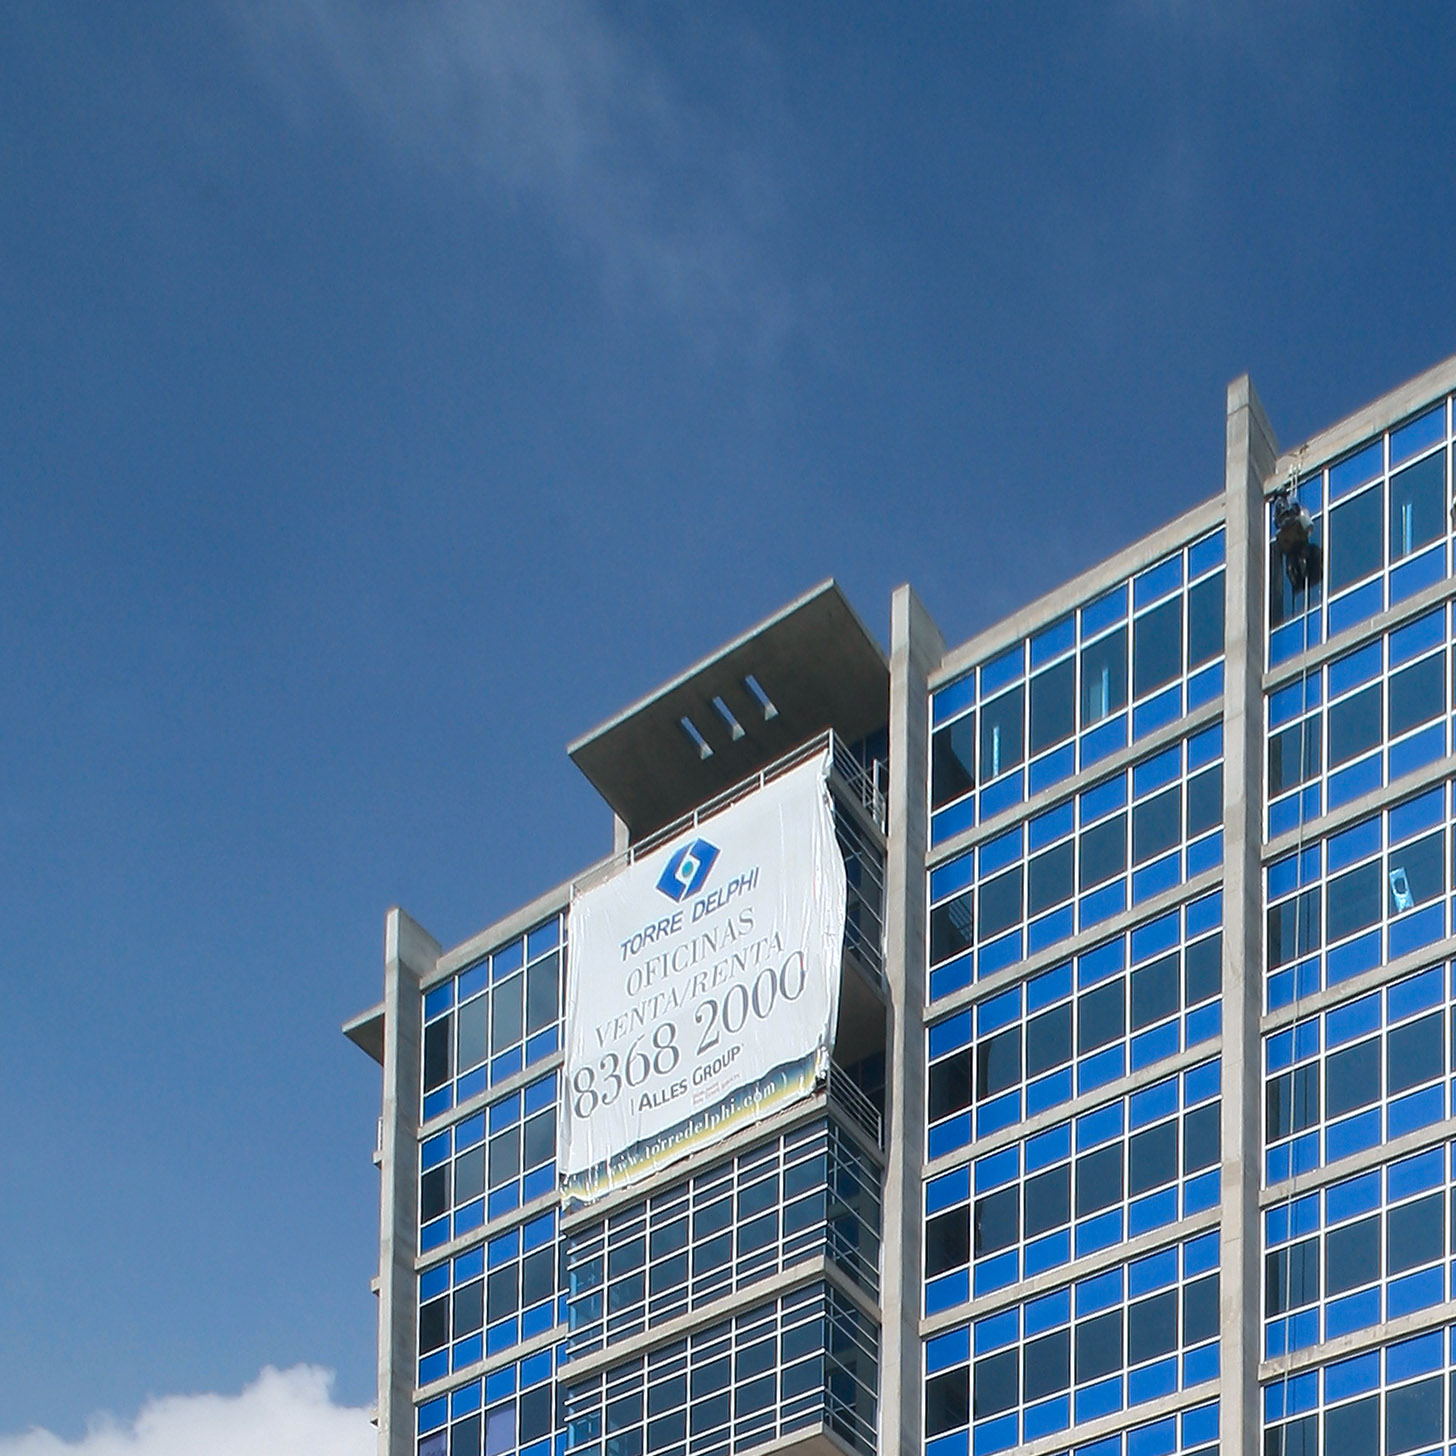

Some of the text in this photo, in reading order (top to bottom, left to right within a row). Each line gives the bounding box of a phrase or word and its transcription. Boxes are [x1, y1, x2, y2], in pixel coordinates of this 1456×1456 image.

[620, 866, 760, 961] TORRE DELPHI
[627, 907, 754, 996] OFICINAS
[573, 951, 805, 1118] 8368 2000
[596, 932, 783, 1047] VENTA/RENTA
[638, 1079, 688, 1111] ALLES
[693, 1044, 742, 1086] GROUP
